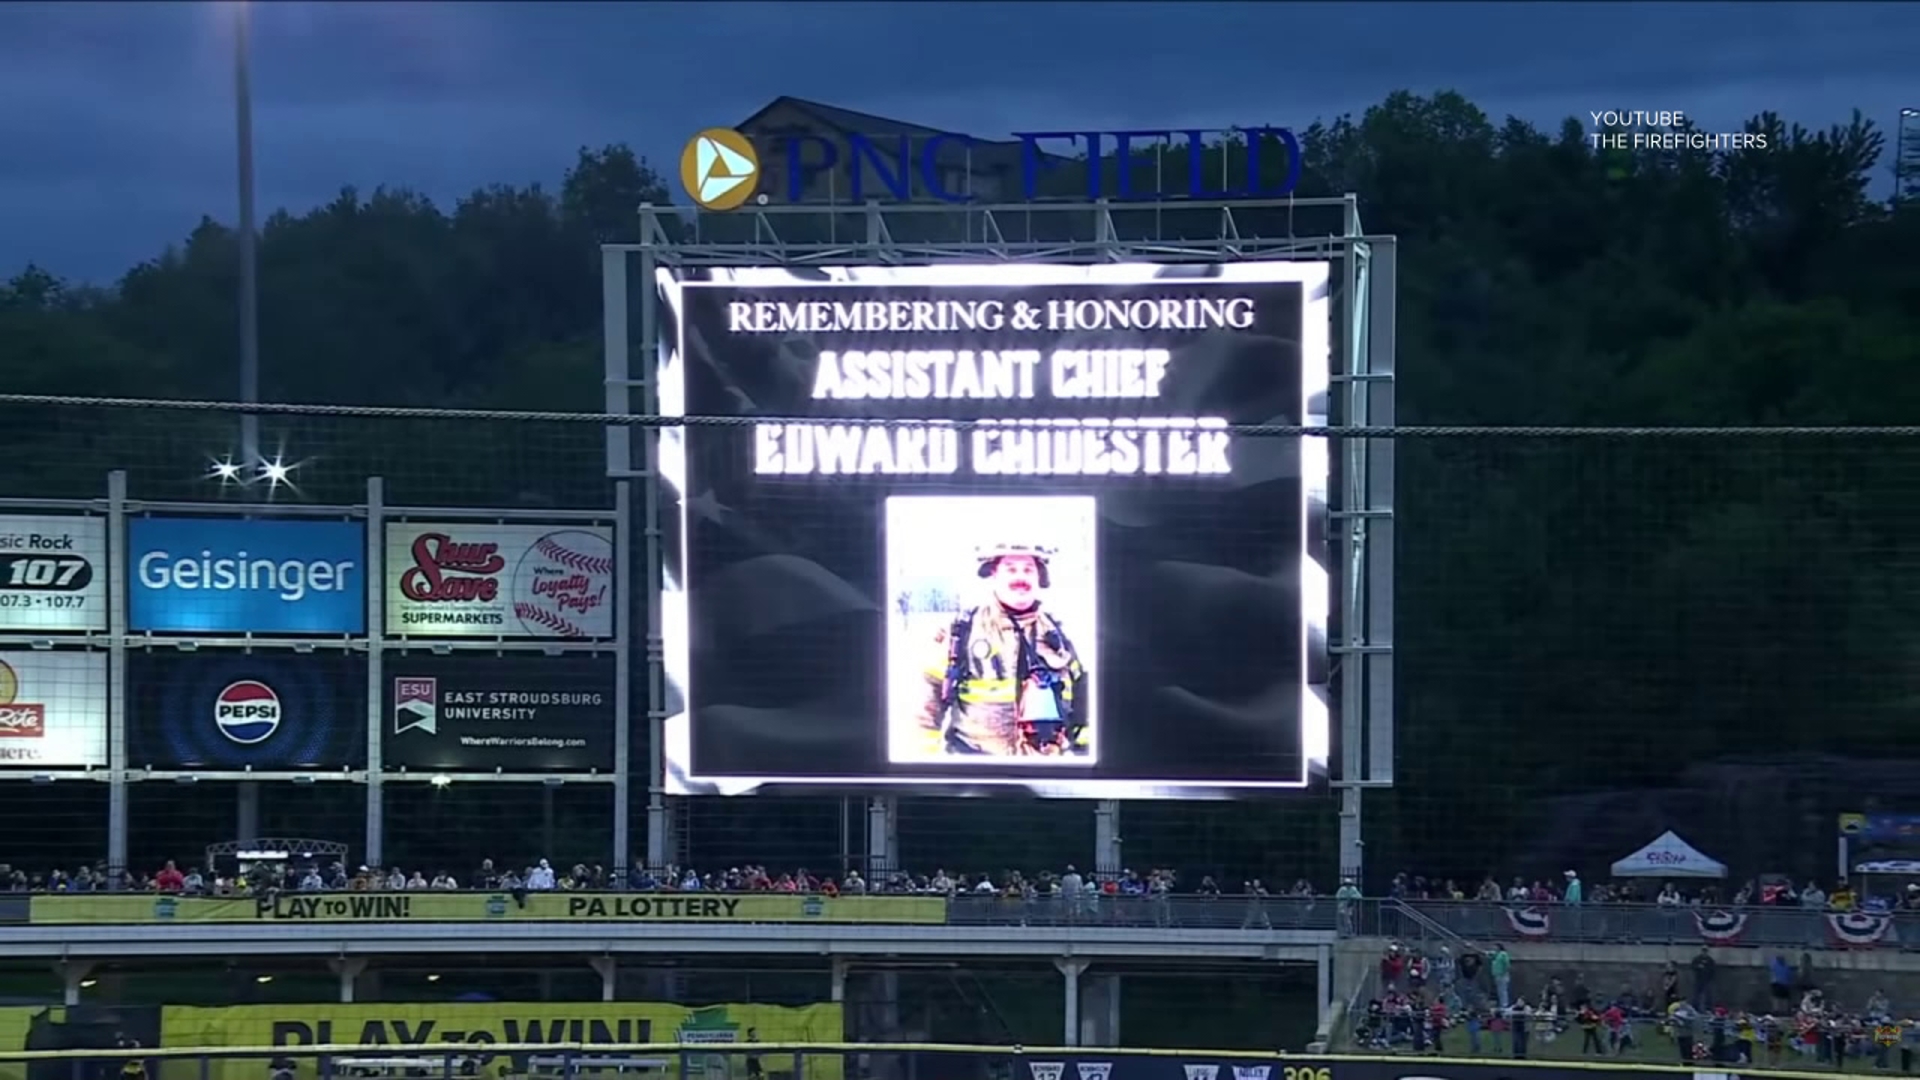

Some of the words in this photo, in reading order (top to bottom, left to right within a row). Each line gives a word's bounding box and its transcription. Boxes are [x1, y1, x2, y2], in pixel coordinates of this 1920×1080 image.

[783, 132, 976, 204] PNC
[1011, 127, 1299, 200] FIELD
[728, 300, 1002, 332] REMEMBERING
[1011, 302, 1042, 330] &
[1047, 298, 1255, 330] HONORING
[811, 349, 1041, 399] ASSISTANT
[1051, 348, 1171, 398] CHIEF
[754, 418, 957, 475] EDWARD
[972, 417, 1232, 475] CHIDESTER
[29, 533, 74, 550] Rock
[8, 559, 86, 586] 107
[138, 549, 355, 601] Geisinger
[533, 566, 565, 575] Where
[531, 574, 590, 599] Loyalty
[45, 595, 85, 608] 107.7
[556, 584, 607, 615] Pays!
[402, 611, 503, 625] SUPERMARKETS
[401, 683, 431, 696] ESU
[444, 692, 485, 704] EAST
[489, 692, 602, 705] STROUDSBURG
[219, 704, 277, 719] PEPSI
[444, 707, 537, 720] UNIVERSITY
[460, 736, 586, 748] WhereWarriorsBelong.com
[256, 897, 322, 919] PLAY
[323, 900, 347, 916] TO
[350, 896, 410, 918] WIN!
[569, 897, 607, 917] PA
[615, 897, 740, 917] LOTTERY
